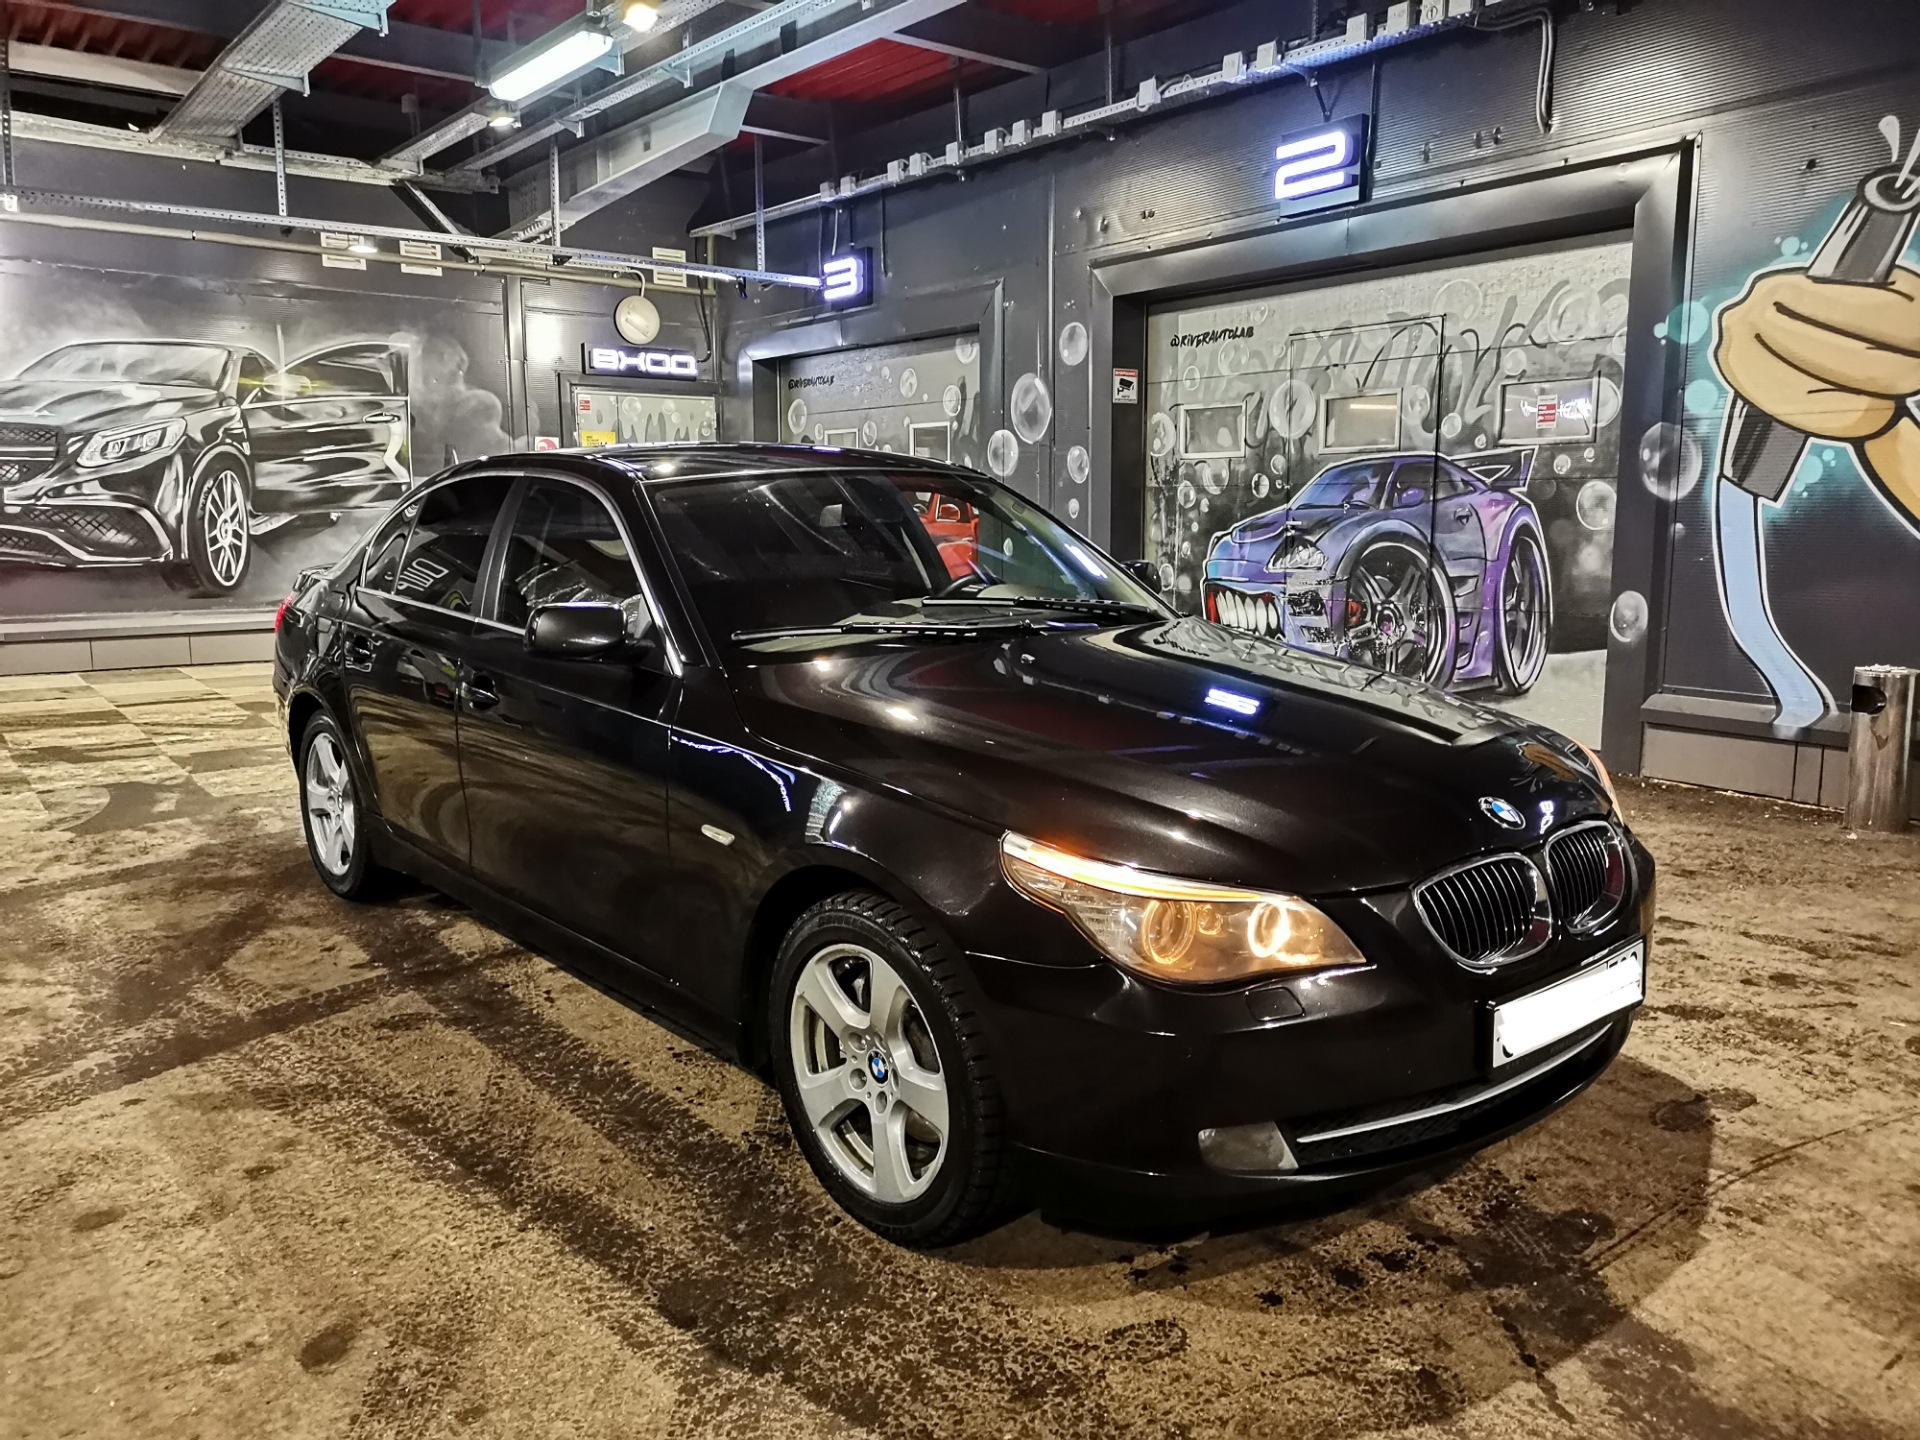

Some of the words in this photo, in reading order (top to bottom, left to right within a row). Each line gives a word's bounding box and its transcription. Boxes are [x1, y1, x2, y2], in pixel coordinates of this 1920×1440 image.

[1274, 131, 1349, 200] 2
[823, 257, 860, 300] 3
[592, 347, 698, 375] ВХОД
